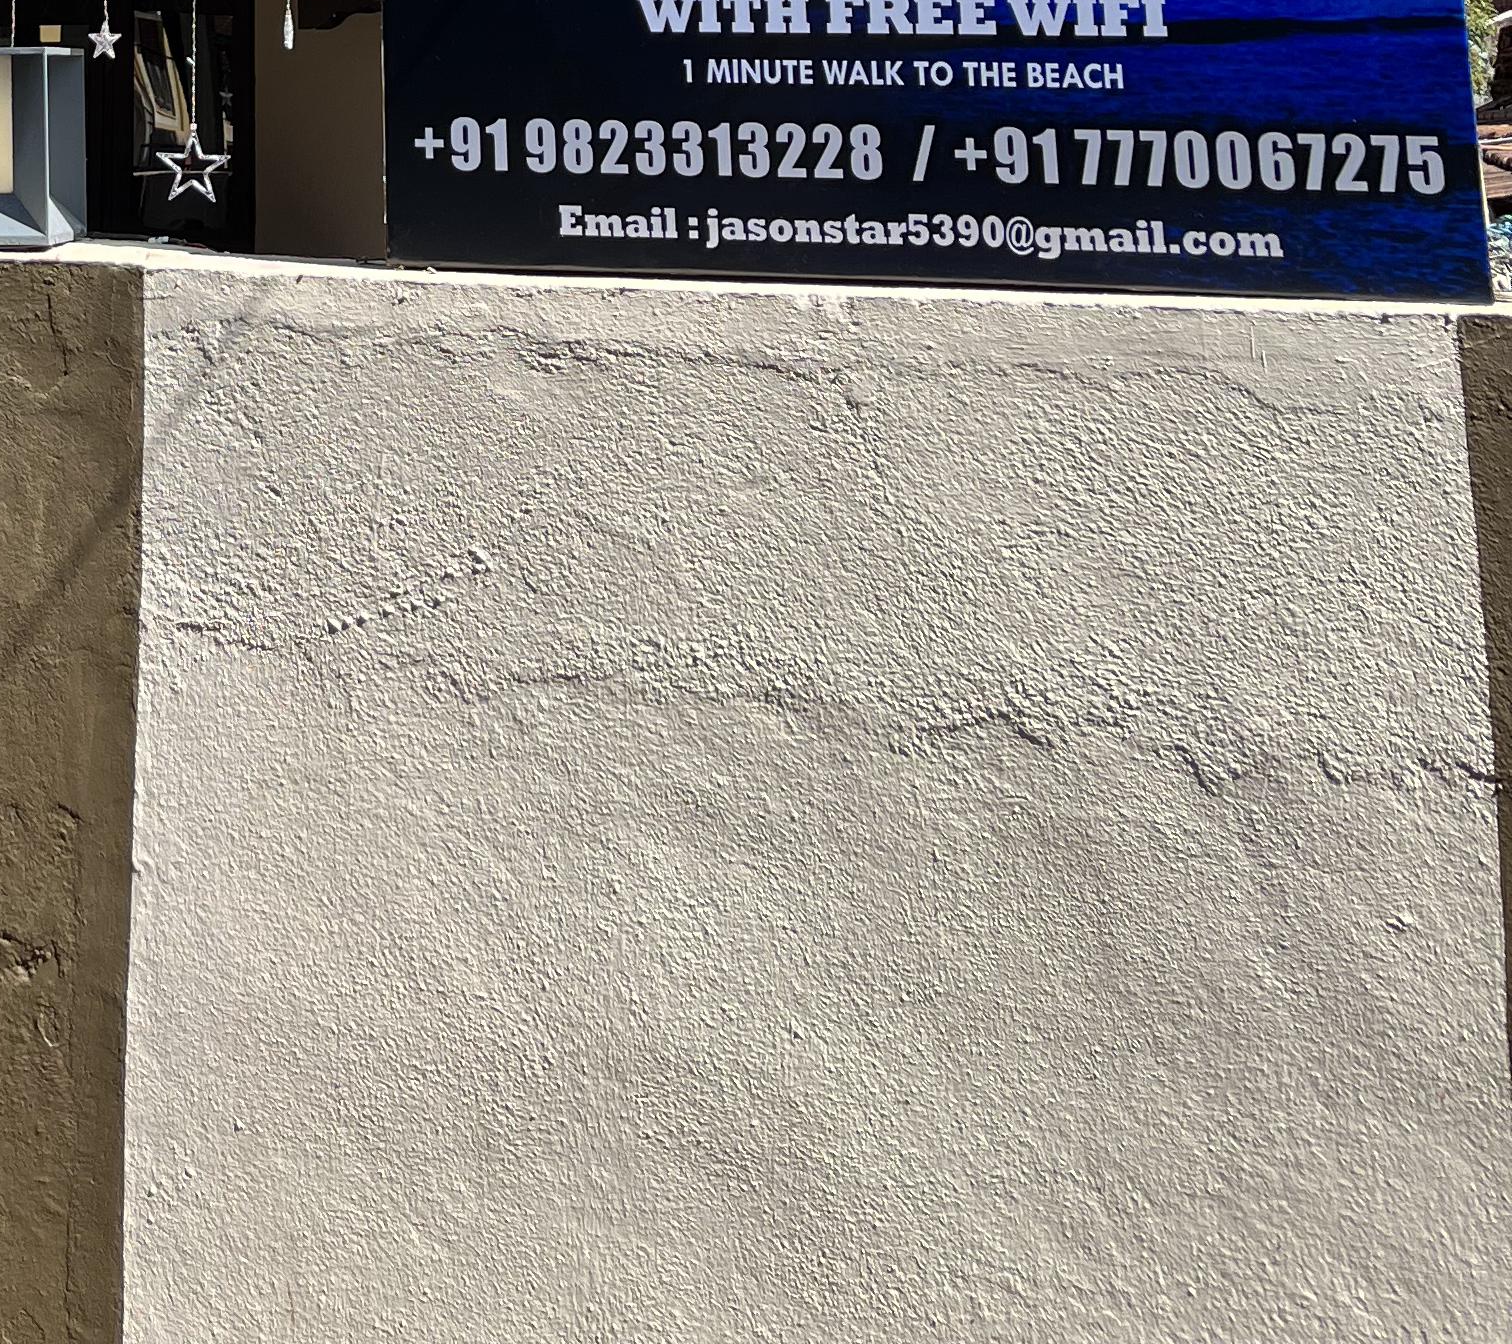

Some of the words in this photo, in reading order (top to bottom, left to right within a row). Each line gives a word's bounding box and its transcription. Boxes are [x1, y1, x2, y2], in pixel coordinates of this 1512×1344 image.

[683, 59, 693, 83] 1
[707, 58, 814, 85] MINUTE
[821, 59, 905, 86] WALK
[913, 60, 954, 87] TO
[962, 61, 1017, 88] THE
[1026, 62, 1124, 89] BEACH
[558, 204, 678, 239] Email
